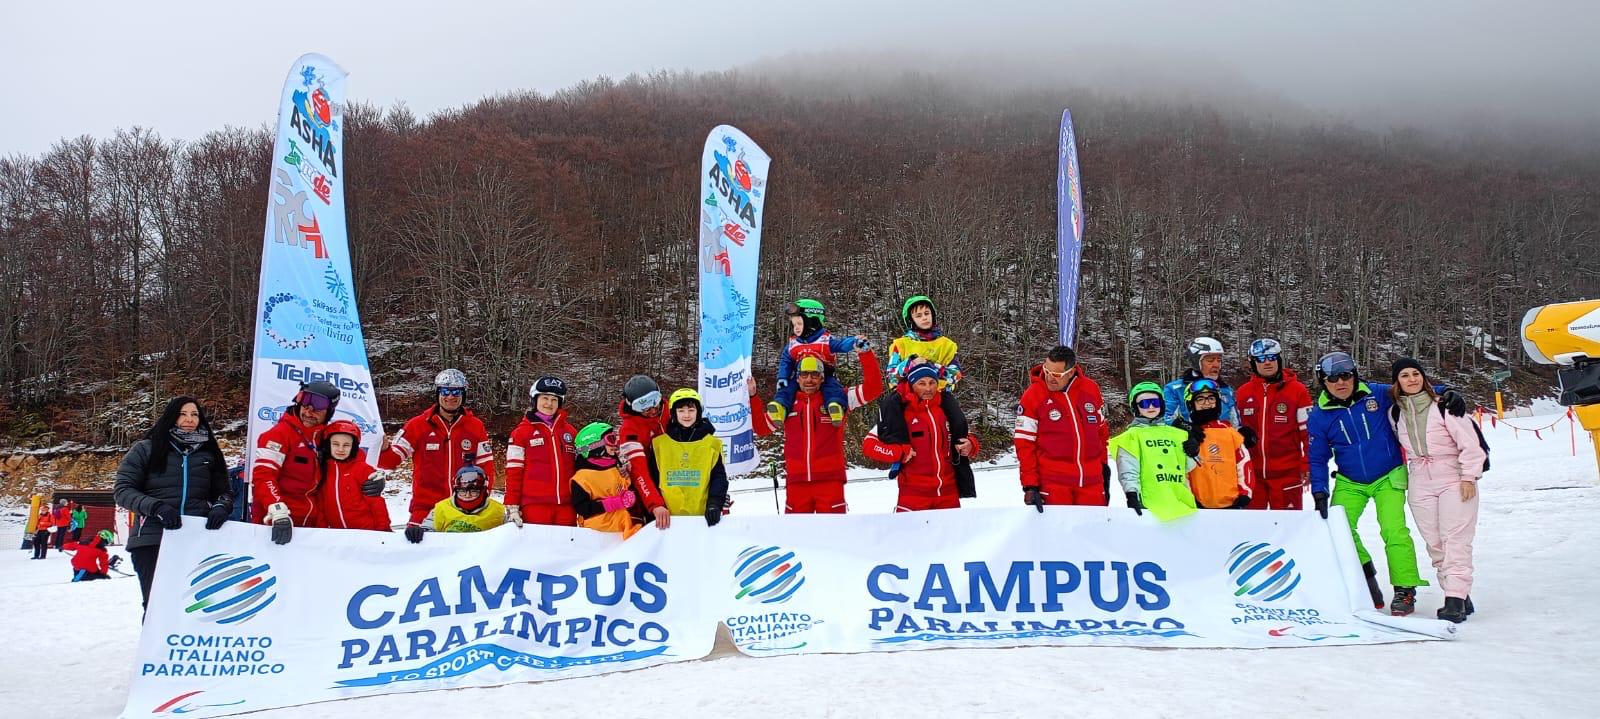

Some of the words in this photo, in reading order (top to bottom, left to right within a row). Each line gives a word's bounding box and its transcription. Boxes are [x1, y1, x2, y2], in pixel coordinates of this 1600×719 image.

[290, 105, 337, 178] ASHA
[709, 163, 756, 228] ASHA
[544, 378, 562, 389] EA7
[733, 442, 754, 454] Roma
[874, 445, 894, 456] ITALIA
[637, 476, 650, 497] ITALIA
[346, 561, 668, 630] CAMPUS
[866, 560, 1171, 613] CAMPUS
[726, 612, 811, 627] COMITATO
[166, 634, 273, 649] COMITATO
[337, 611, 669, 669] PARALIMPICO
[168, 649, 265, 662] ITALIANO
[389, 672, 420, 681] LO
[424, 648, 495, 679] SPORT
[142, 663, 285, 676] PARALIMPICO
